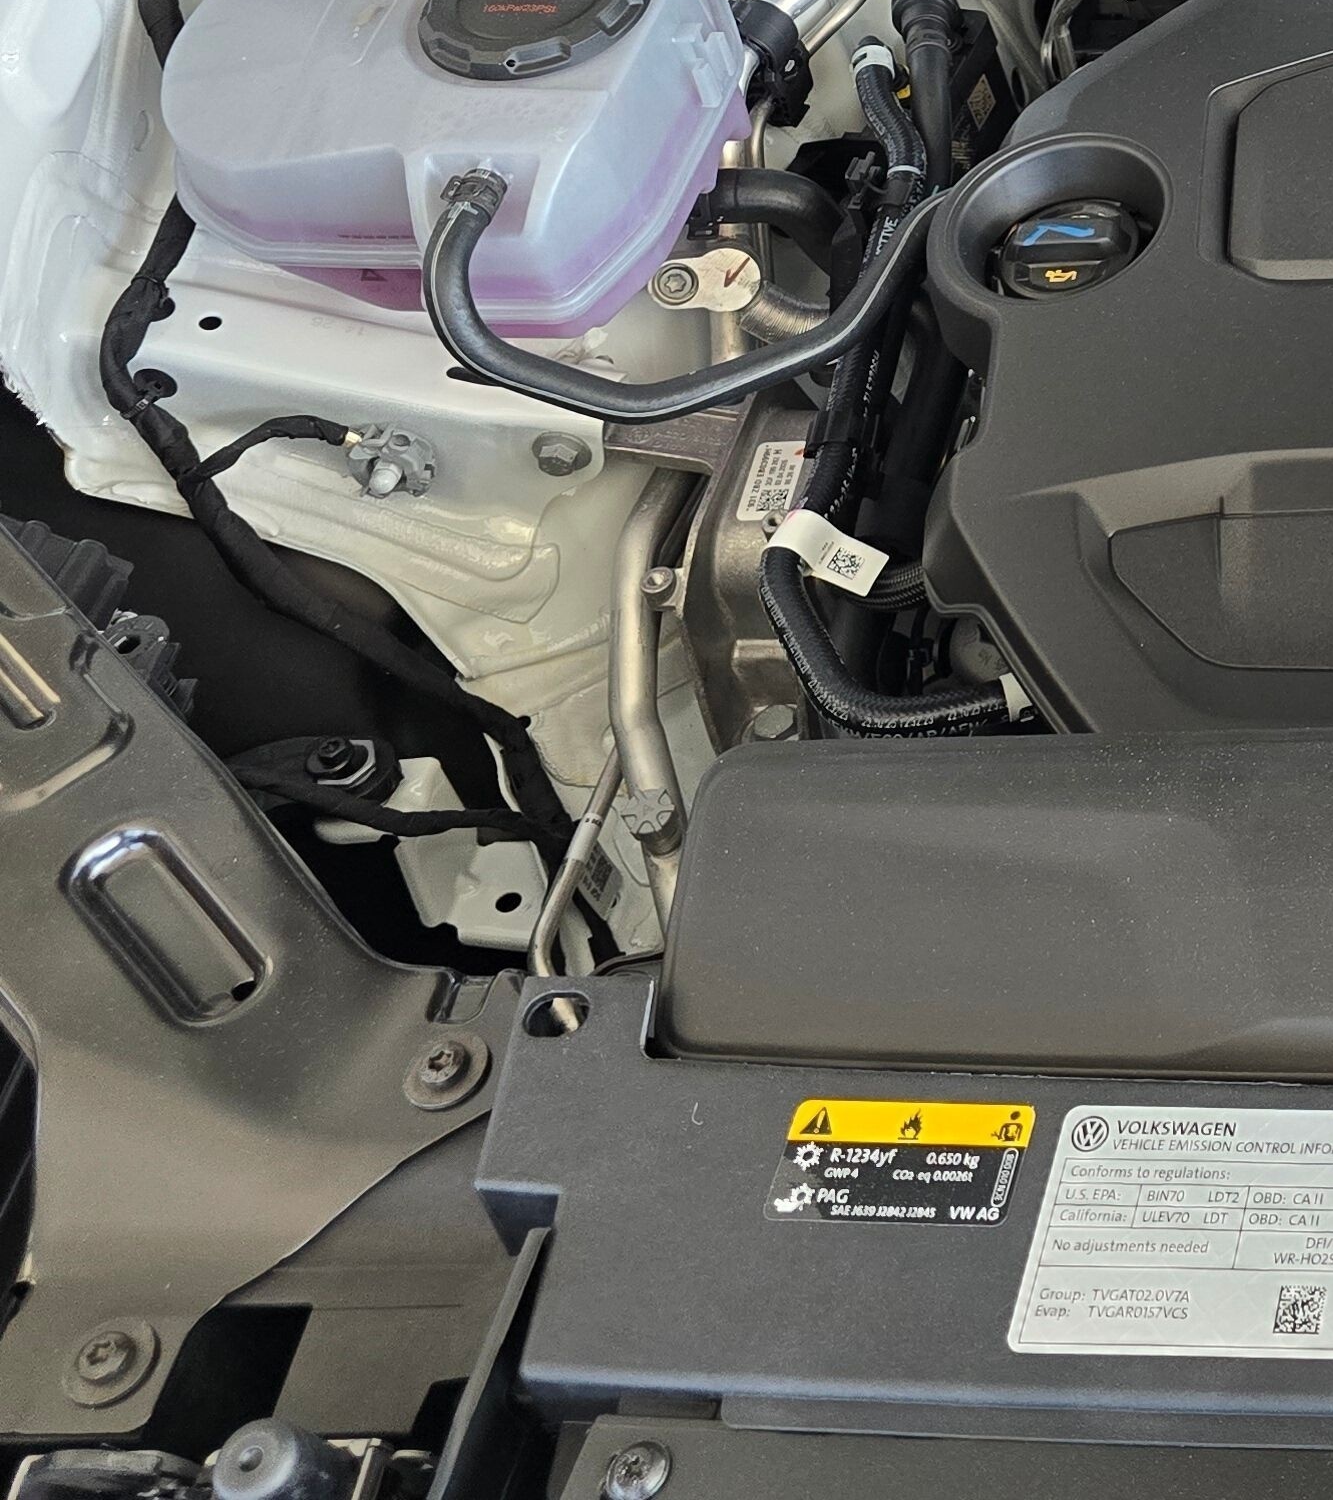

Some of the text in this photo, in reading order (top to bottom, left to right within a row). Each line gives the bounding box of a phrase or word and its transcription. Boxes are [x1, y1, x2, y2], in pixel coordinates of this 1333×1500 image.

[1117, 1119, 1237, 1137] VOLKSWAGEN
[1112, 1138, 1166, 1151] VEHICLE
[1167, 1139, 1232, 1152] EMISSION
[1232, 1141, 1296, 1154] CONTROL
[1070, 1164, 1231, 1182] Conforms to regulations:
[1143, 1189, 1240, 1204] BIN70 LDT2
[1252, 1191, 1286, 1207] OBD:
[1290, 1192, 1311, 1205] CA
[1056, 1207, 1127, 1222] California:
[1139, 1210, 1229, 1225] ULEV70 LDT
[1248, 1212, 1282, 1226] OBD:
[1288, 1214, 1307, 1226] CA
[1051, 1238, 1209, 1255] No adjustments needed
[1038, 1287, 1086, 1304] Group:
[1033, 1303, 1071, 1321] Evap:
